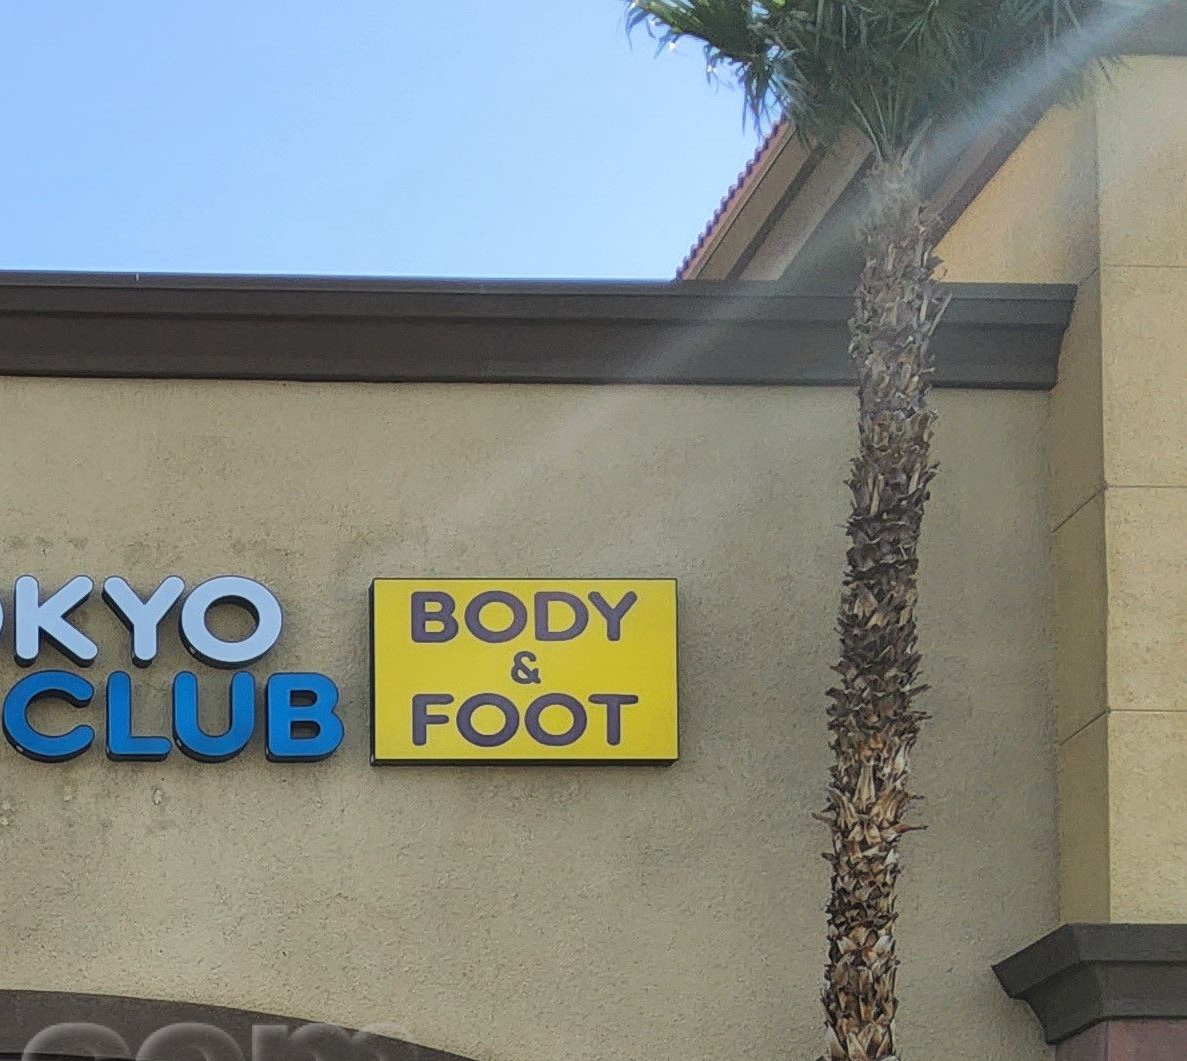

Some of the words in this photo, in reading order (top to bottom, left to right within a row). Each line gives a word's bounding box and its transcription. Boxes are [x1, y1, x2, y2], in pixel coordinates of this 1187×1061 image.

[410, 590, 638, 643] BODY
[510, 650, 542, 685] &
[2, 669, 345, 763] CLUB
[410, 693, 639, 747] FOOT
